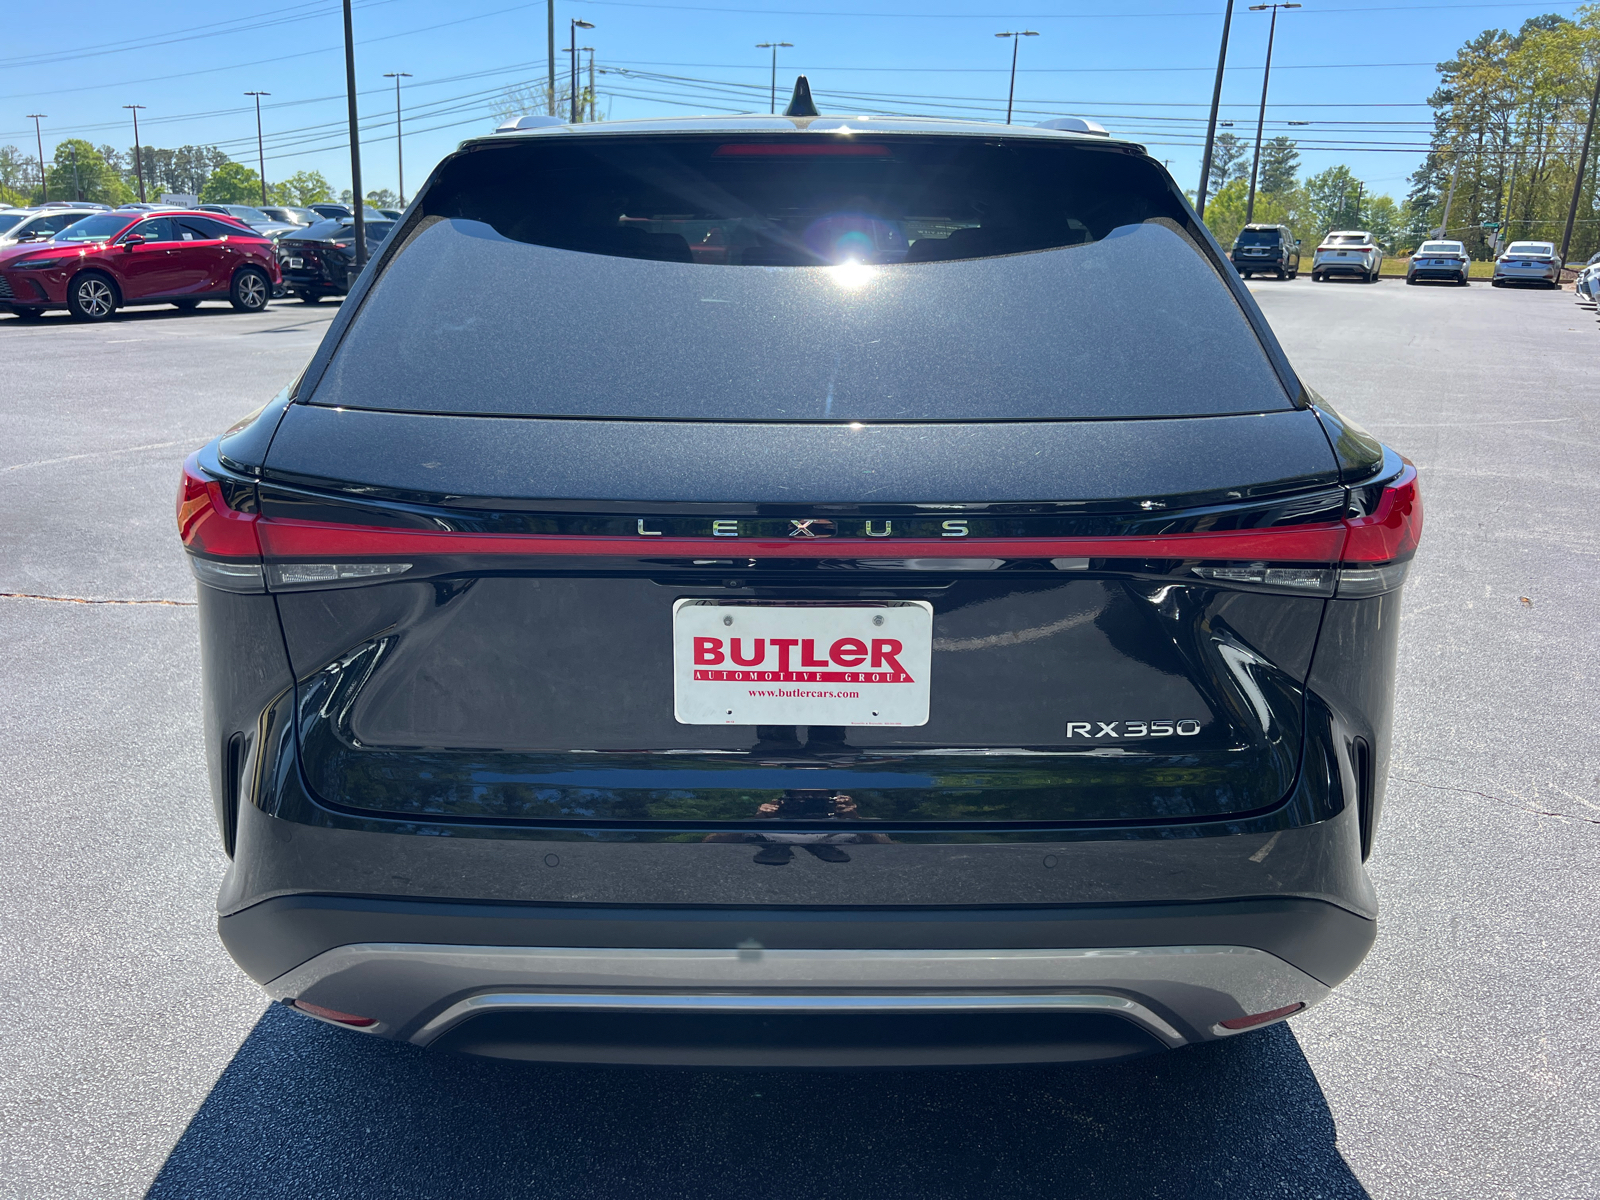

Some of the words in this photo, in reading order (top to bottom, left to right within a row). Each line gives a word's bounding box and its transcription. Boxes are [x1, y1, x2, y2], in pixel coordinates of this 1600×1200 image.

[637, 518, 969, 538] LEXUS
[695, 671, 823, 682] AUTOMOTIVE
[844, 672, 907, 682] GROUP
[748, 688, 860, 699] www.butlercars.com
[1066, 719, 1201, 738] RX350
